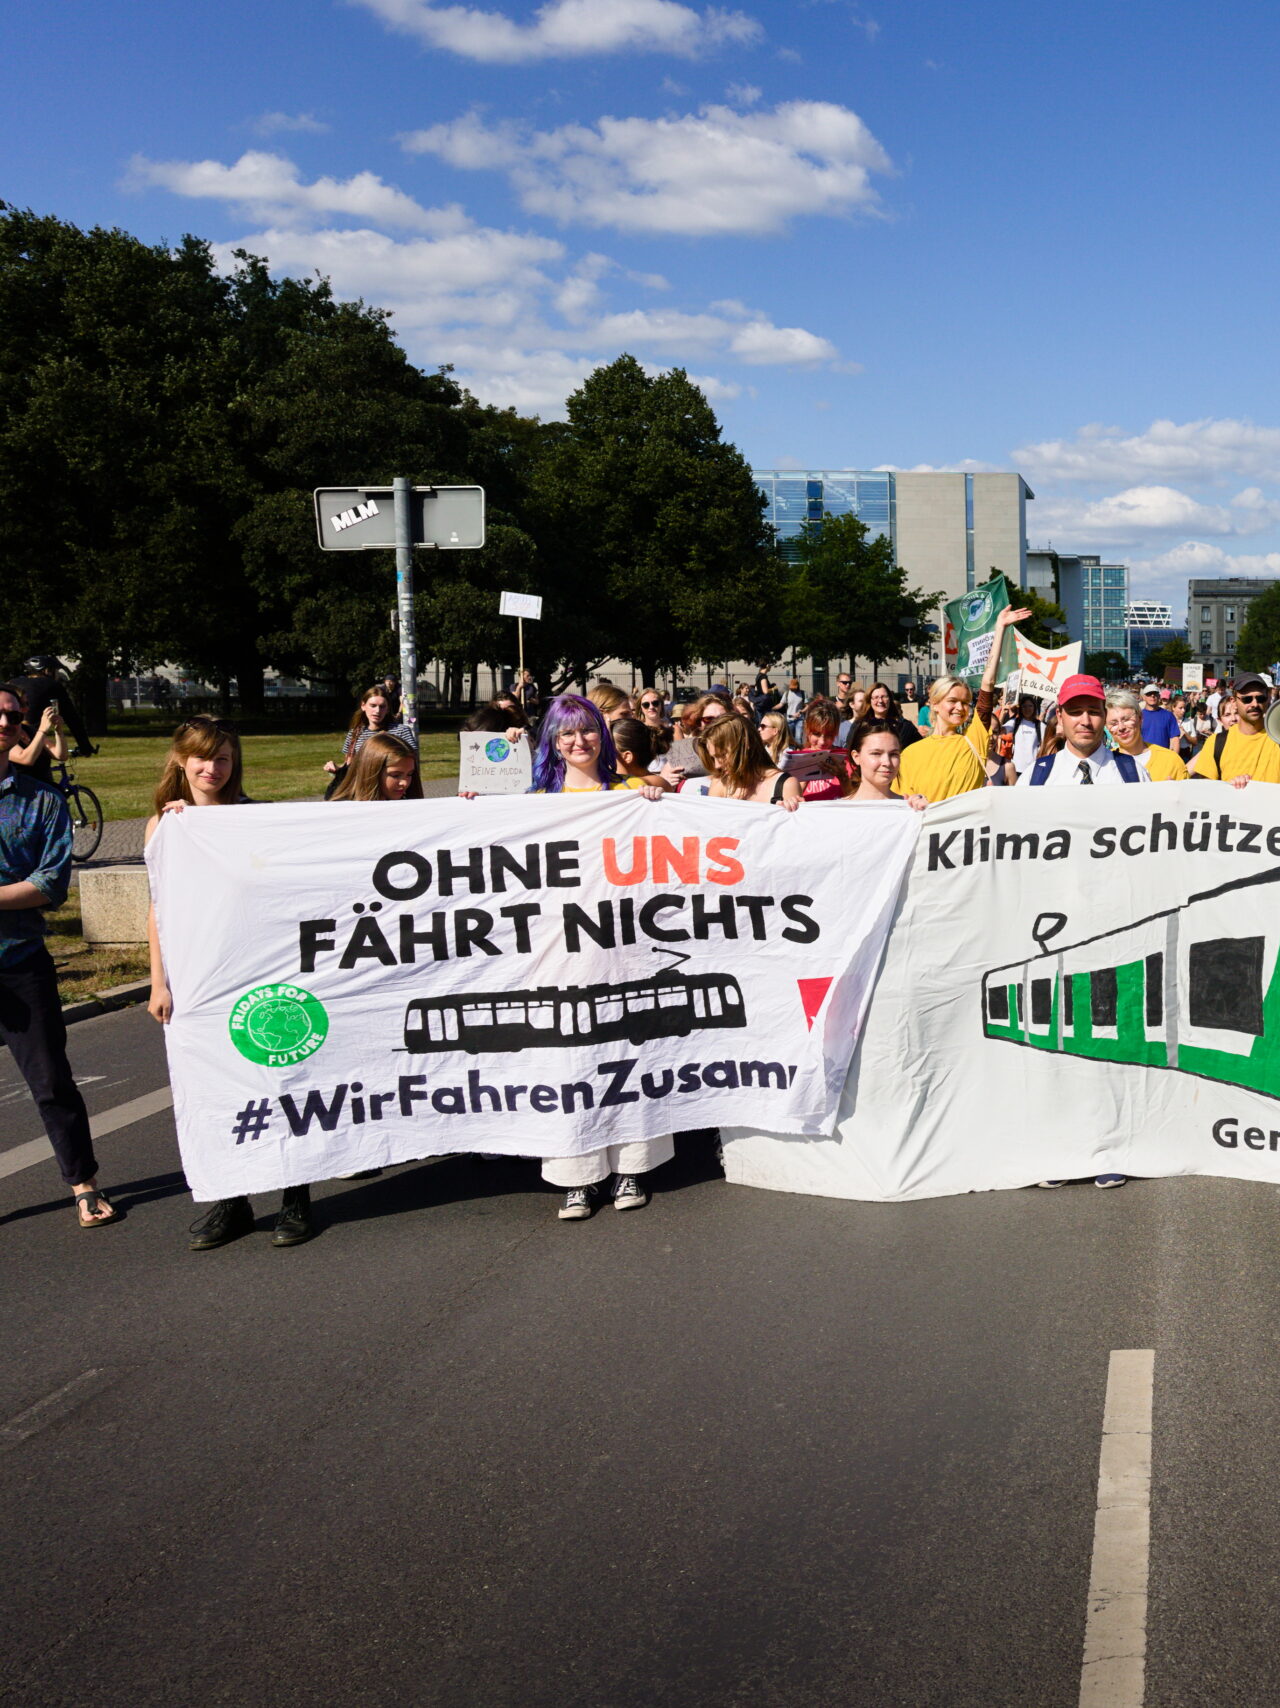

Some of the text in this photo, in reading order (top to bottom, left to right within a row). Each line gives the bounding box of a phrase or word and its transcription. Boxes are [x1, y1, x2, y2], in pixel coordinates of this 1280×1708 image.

[330, 499, 380, 532] MLM
[471, 766, 496, 776] DEINE
[373, 835, 745, 901] OHNE UNS
[928, 826, 1071, 872] Klima
[300, 893, 820, 973] FÄHRT NICHTS
[231, 986, 308, 1030] FRIDAYS FOR
[268, 1033, 325, 1065] FUTURE
[231, 1058, 798, 1145] #WirFahrenZusam
